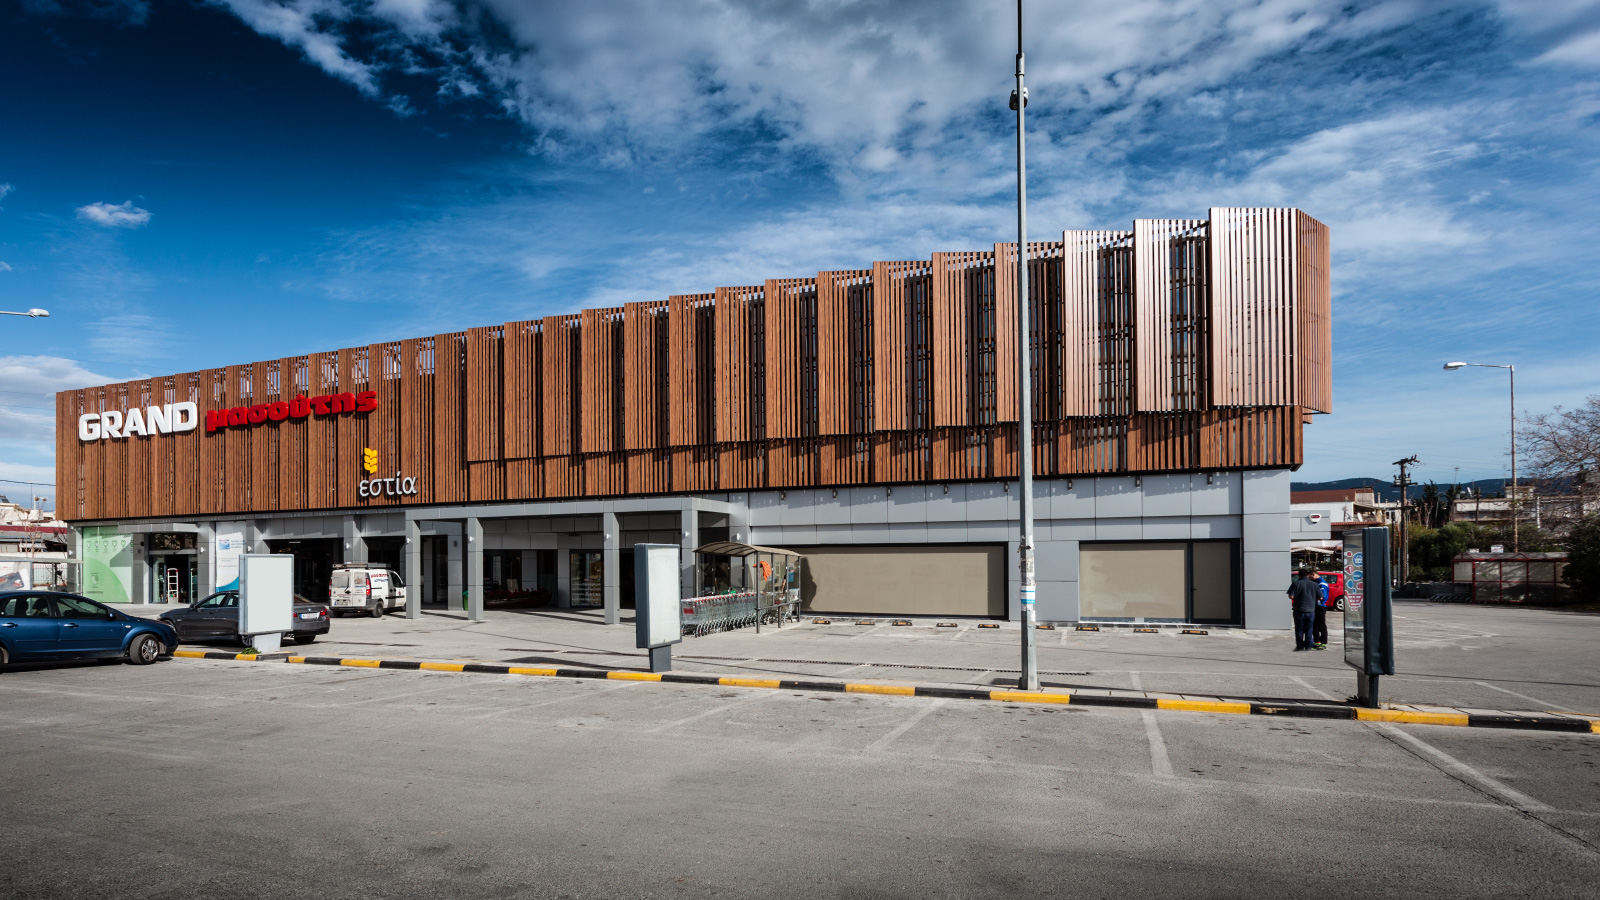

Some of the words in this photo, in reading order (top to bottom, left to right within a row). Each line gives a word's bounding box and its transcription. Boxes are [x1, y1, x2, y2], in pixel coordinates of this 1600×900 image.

[78, 401, 198, 442] GRAND
[206, 390, 378, 432] μασούτης
[359, 471, 418, 498] εστία
